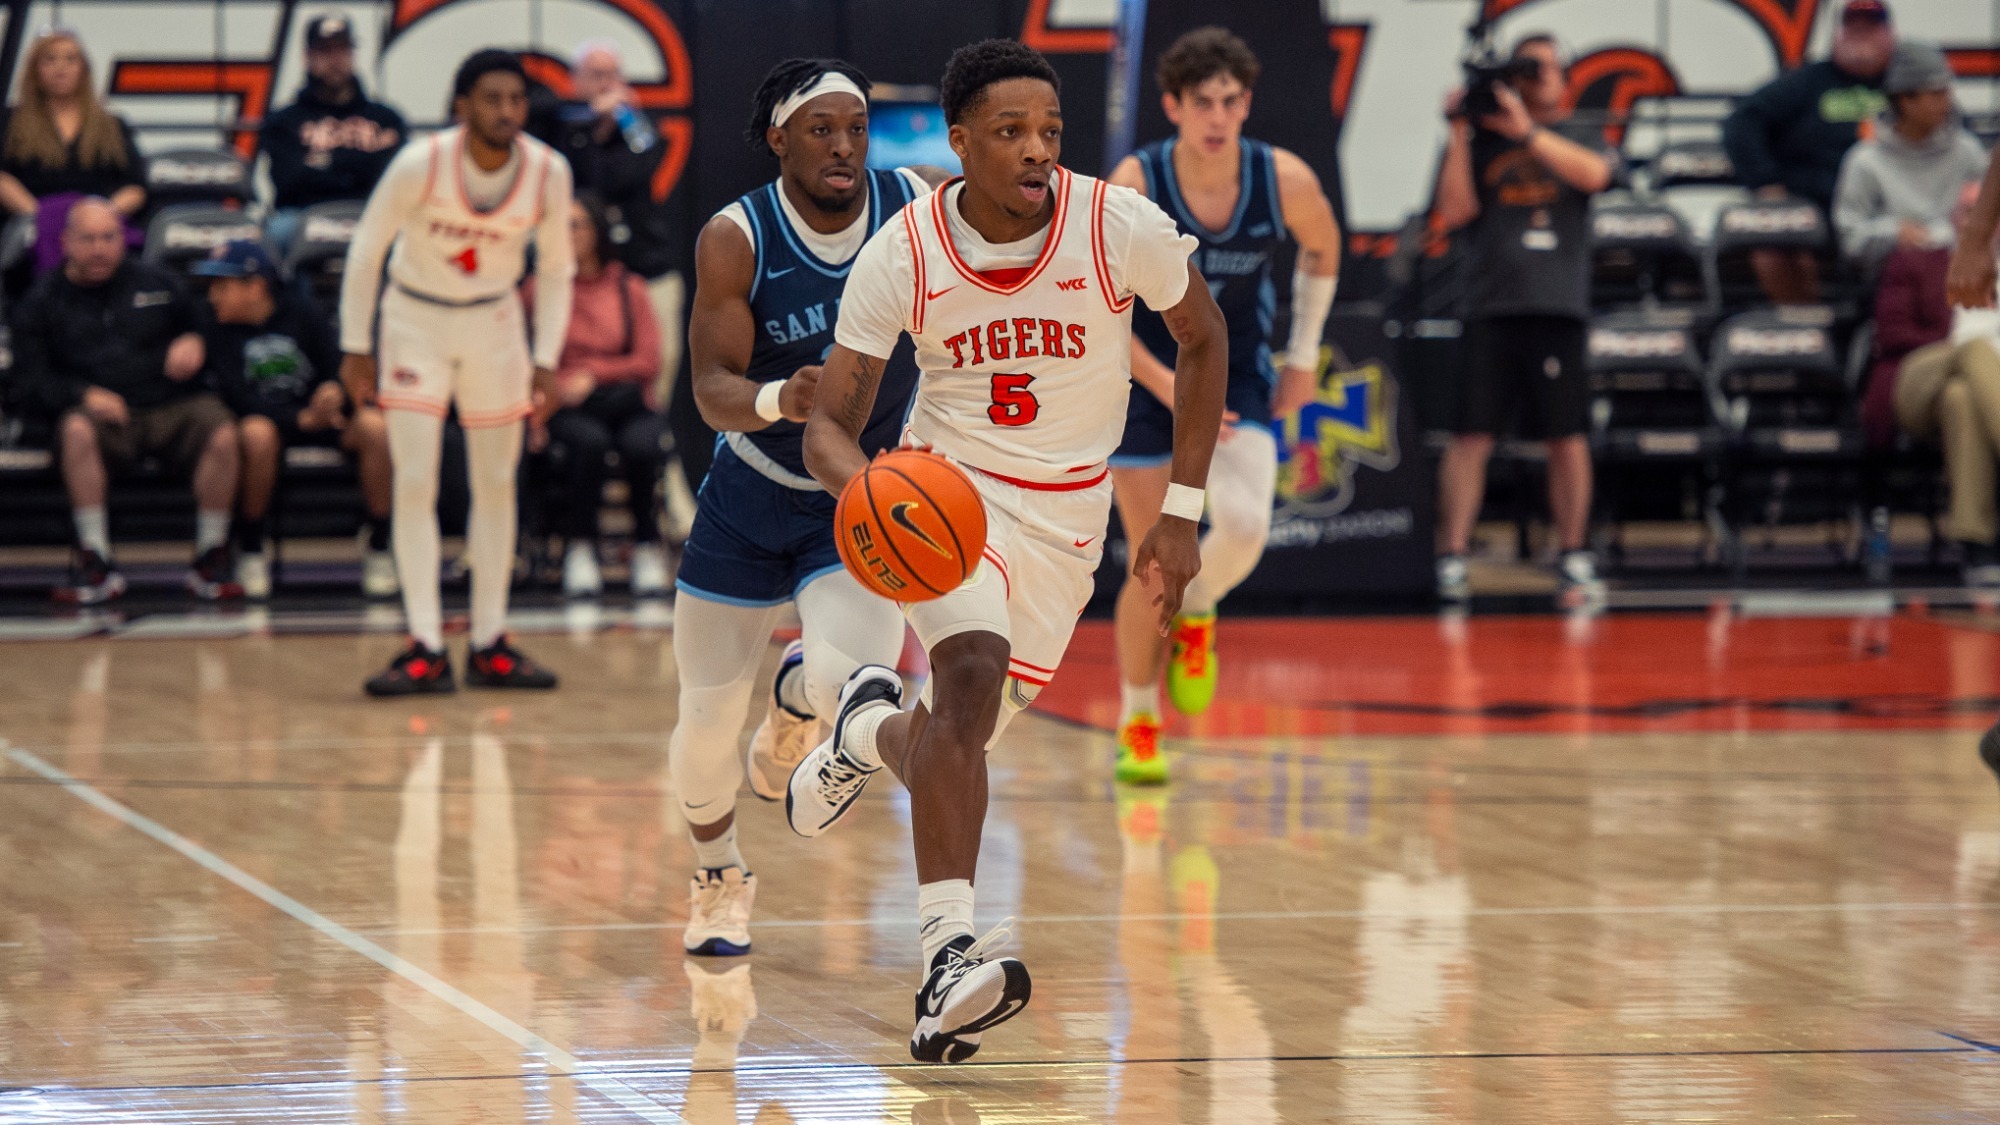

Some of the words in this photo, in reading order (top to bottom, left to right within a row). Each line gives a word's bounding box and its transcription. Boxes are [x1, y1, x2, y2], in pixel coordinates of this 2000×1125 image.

[1055, 277, 1088, 292] WCC
[765, 303, 828, 345] SAN
[943, 317, 1086, 369] TIGERS
[987, 372, 1042, 427] 5
[852, 520, 908, 593] ELITE
